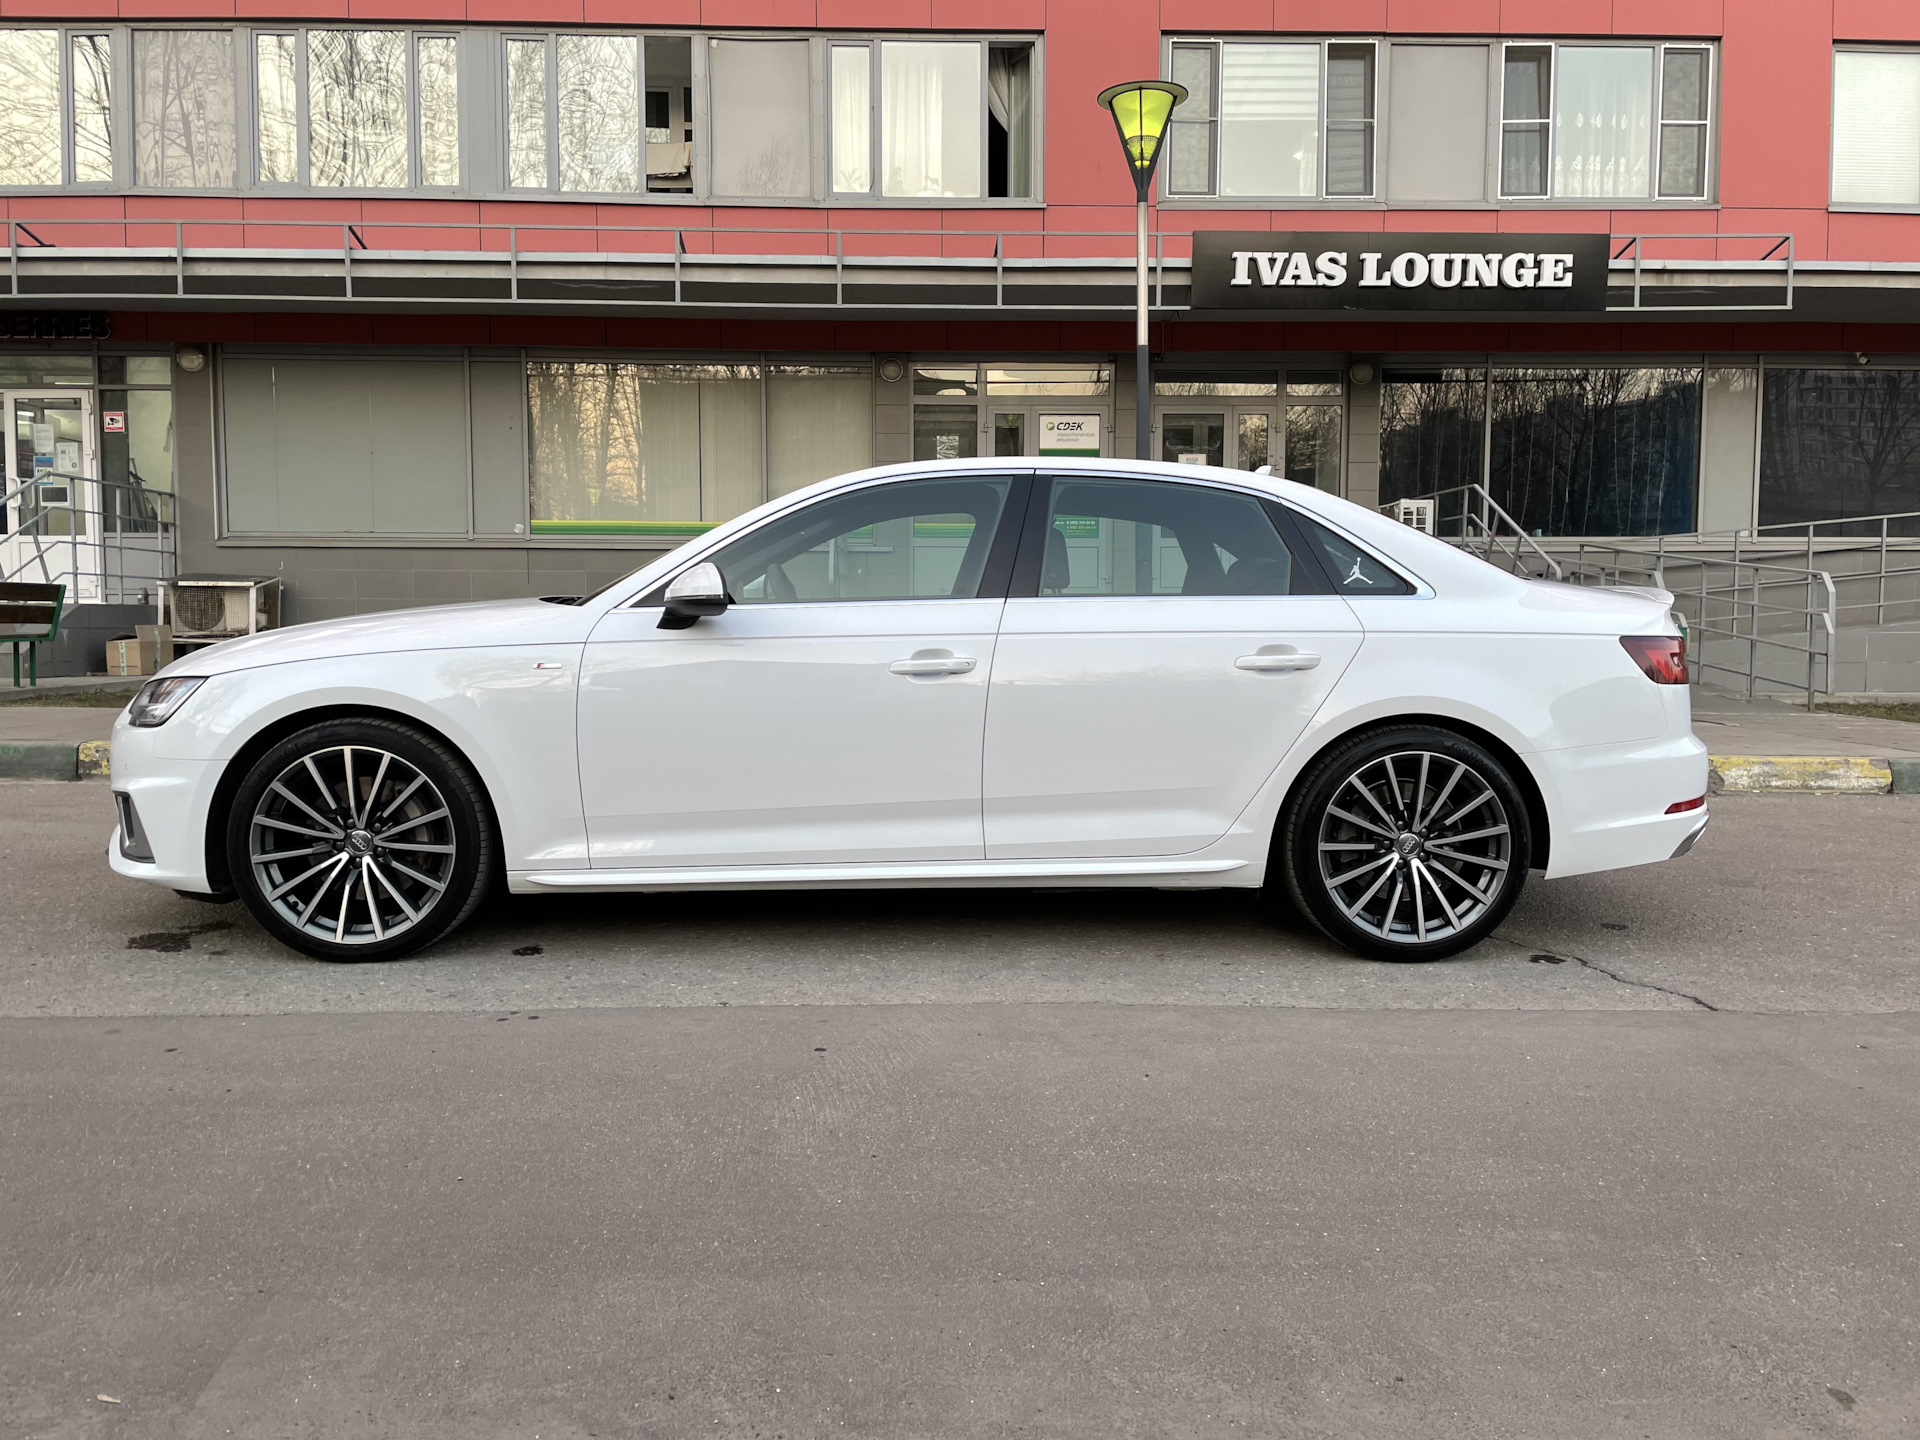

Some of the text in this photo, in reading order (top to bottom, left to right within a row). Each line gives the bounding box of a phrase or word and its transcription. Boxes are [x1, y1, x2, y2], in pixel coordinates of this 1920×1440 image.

[1230, 251, 1574, 289] IVAS LOUNGE
[1056, 422, 1085, 431] CDEK
